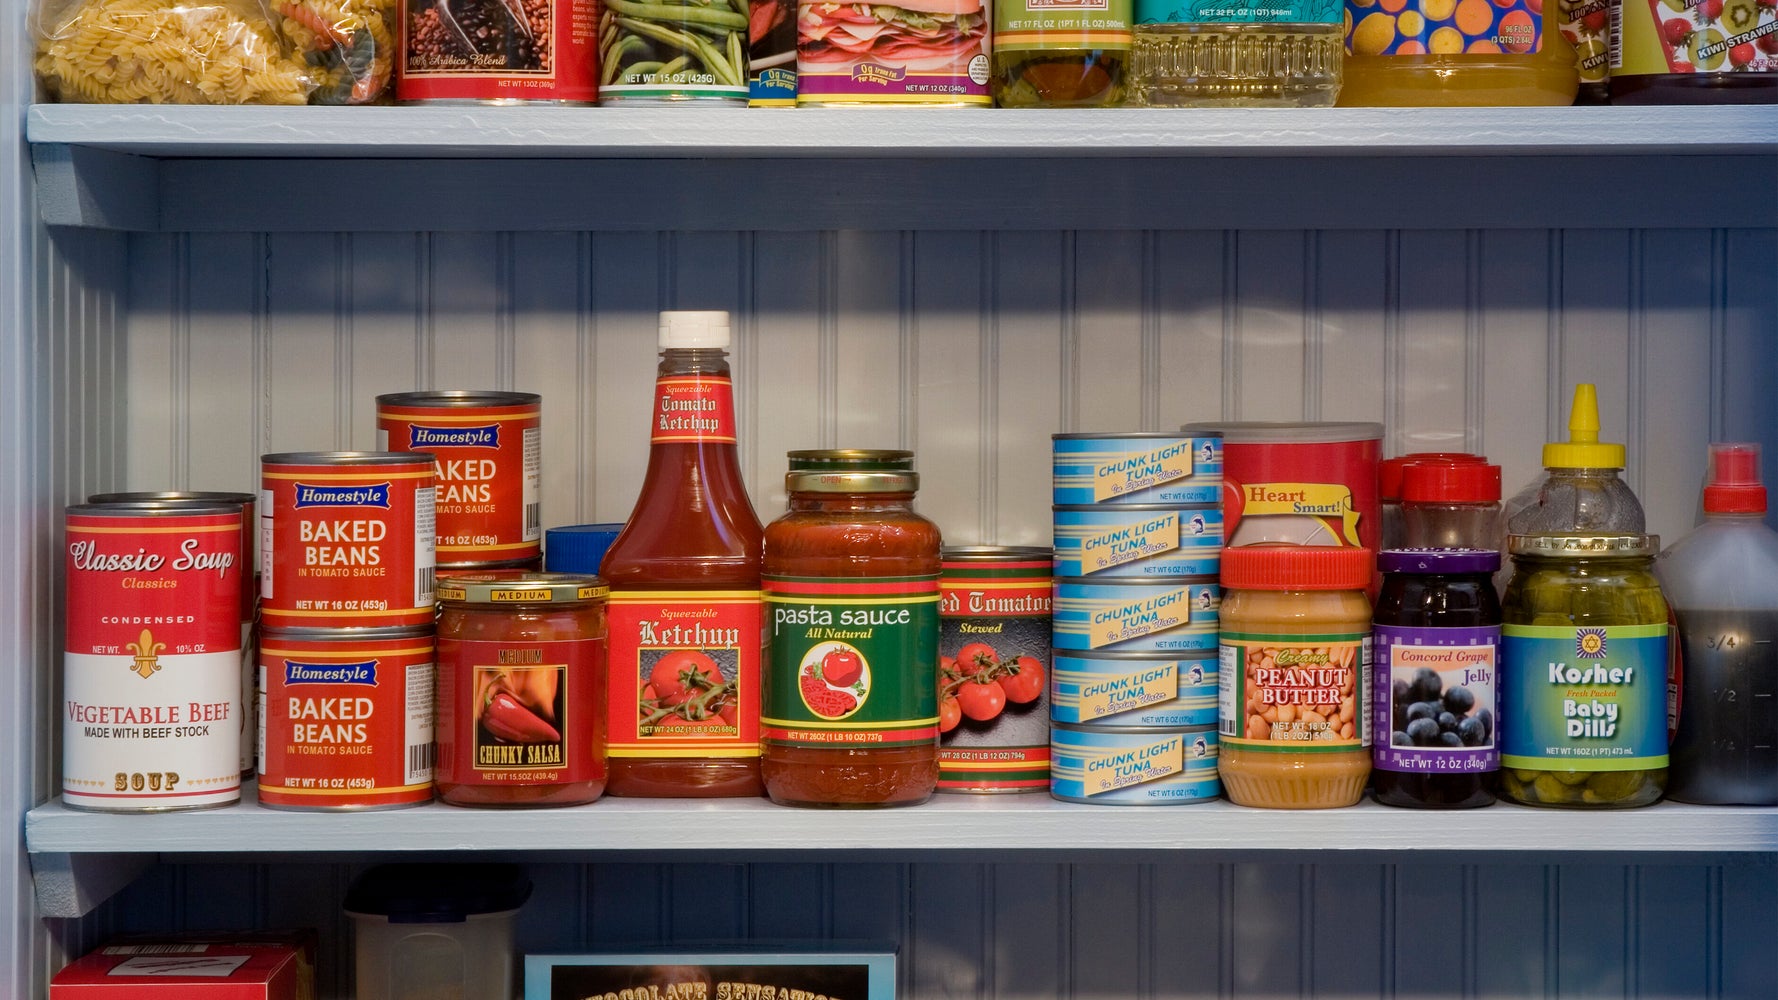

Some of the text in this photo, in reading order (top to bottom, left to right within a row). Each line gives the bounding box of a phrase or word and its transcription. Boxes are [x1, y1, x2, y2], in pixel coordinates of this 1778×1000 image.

[1249, 9, 1268, 17] (1QT)
[1009, 20, 1022, 28] NET
[1023, 20, 1032, 28] 17
[1033, 20, 1043, 28] FL
[1044, 20, 1055, 28] OZ
[1057, 20, 1073, 29] (1PT
[1076, 20, 1080, 28] 1
[1081, 20, 1091, 28] FL
[1092, 20, 1105, 29] OZ)
[1514, 25, 1522, 33] FL
[1523, 25, 1532, 33] OZ
[1697, 21, 1778, 58] KIWI STRAWBE
[409, 53, 506, 66] 100% Arabica Blend
[625, 73, 715, 84] NET WT 15 OZ (425G)
[905, 84, 919, 92] NET
[919, 84, 930, 92] WT
[930, 84, 938, 92] 12
[938, 84, 949, 92] OZ
[665, 384, 712, 395] Squeezable
[661, 396, 716, 411] Tomato
[659, 414, 718, 432] Ketchup
[416, 430, 491, 444] Homestyle
[1098, 442, 1188, 477] CHUNK LIGHT
[436, 459, 496, 480] AKED
[1125, 463, 1163, 482] TUNA
[301, 488, 381, 504] Homestyle
[436, 484, 491, 502] EANS
[1249, 487, 1306, 502] Heart
[436, 504, 496, 513] MATO SAUCE
[1293, 501, 1341, 514] Smart!
[300, 520, 386, 541] BAKED
[1084, 515, 1173, 550] CHUNK LIGHT
[1110, 536, 1146, 555] TUNA
[69, 538, 234, 579] Classic Soup
[305, 545, 380, 565] BEANS
[1109, 550, 1139, 564] Spring
[298, 567, 386, 577] IN TOMATO SAUCE
[121, 577, 177, 589] Classics
[496, 591, 546, 600] MEDIUM
[940, 591, 1051, 612] ed Tomatoe
[296, 599, 387, 611] NET WT 16 OZ (453g)
[1095, 590, 1184, 624] CHUNK LIGHT
[101, 614, 195, 625] CONDENSED
[660, 608, 718, 621] Squeezable
[775, 605, 910, 635] pasta sauce
[1120, 611, 1158, 629] TUNA
[638, 620, 739, 650] Ketchup
[804, 627, 873, 639] All Natural
[959, 622, 1003, 633] Stewed
[92, 645, 121, 654] NET WT.
[194, 643, 207, 653] OZ.
[1706, 635, 1735, 649] 3/4
[498, 648, 543, 663] MEDIUM
[1275, 649, 1329, 665] Creamy
[1400, 650, 1489, 664] Concord Grape
[289, 666, 369, 681] Homestyle
[1255, 667, 1348, 688] PEANUT
[1461, 669, 1492, 686] Jelly
[1548, 662, 1633, 684] Kosher
[1083, 665, 1172, 697] CHUNK LIGHT
[1107, 686, 1145, 704] TUNA
[1261, 688, 1343, 706] BUTTER
[1566, 690, 1617, 698] Fresh Packed
[67, 700, 230, 723] VEGETABLE BEEF
[288, 697, 374, 719] BAKED
[1563, 699, 1618, 721] Baby
[84, 725, 209, 739] MADE WITH BEEF STOCK
[293, 723, 368, 743] BEANS
[1272, 722, 1332, 730] NET WT 18 OZ
[1567, 718, 1616, 737] Dills
[787, 731, 800, 739] NET
[800, 732, 810, 740] WT
[827, 732, 834, 742] (1
[834, 732, 845, 741] LB
[845, 732, 854, 741] 10
[853, 732, 867, 742] OZ)
[867, 732, 883, 742] 737g
[287, 745, 373, 755] IN TOMATO SAUCE
[479, 744, 562, 764] CHUNKY SALSA
[1088, 739, 1177, 771] CHUNK LIGHT
[1546, 747, 1559, 755] NET
[1560, 747, 1572, 755] WT
[1591, 747, 1598, 757] (1
[1599, 747, 1611, 757] PT)
[1611, 747, 1624, 755] 473
[1114, 760, 1151, 777] TUNA
[1398, 758, 1487, 770] NET WT 12 OZ (340g)
[114, 771, 180, 791] SOUP
[482, 772, 559, 782] NET WT 15.5OZ (439.4g)
